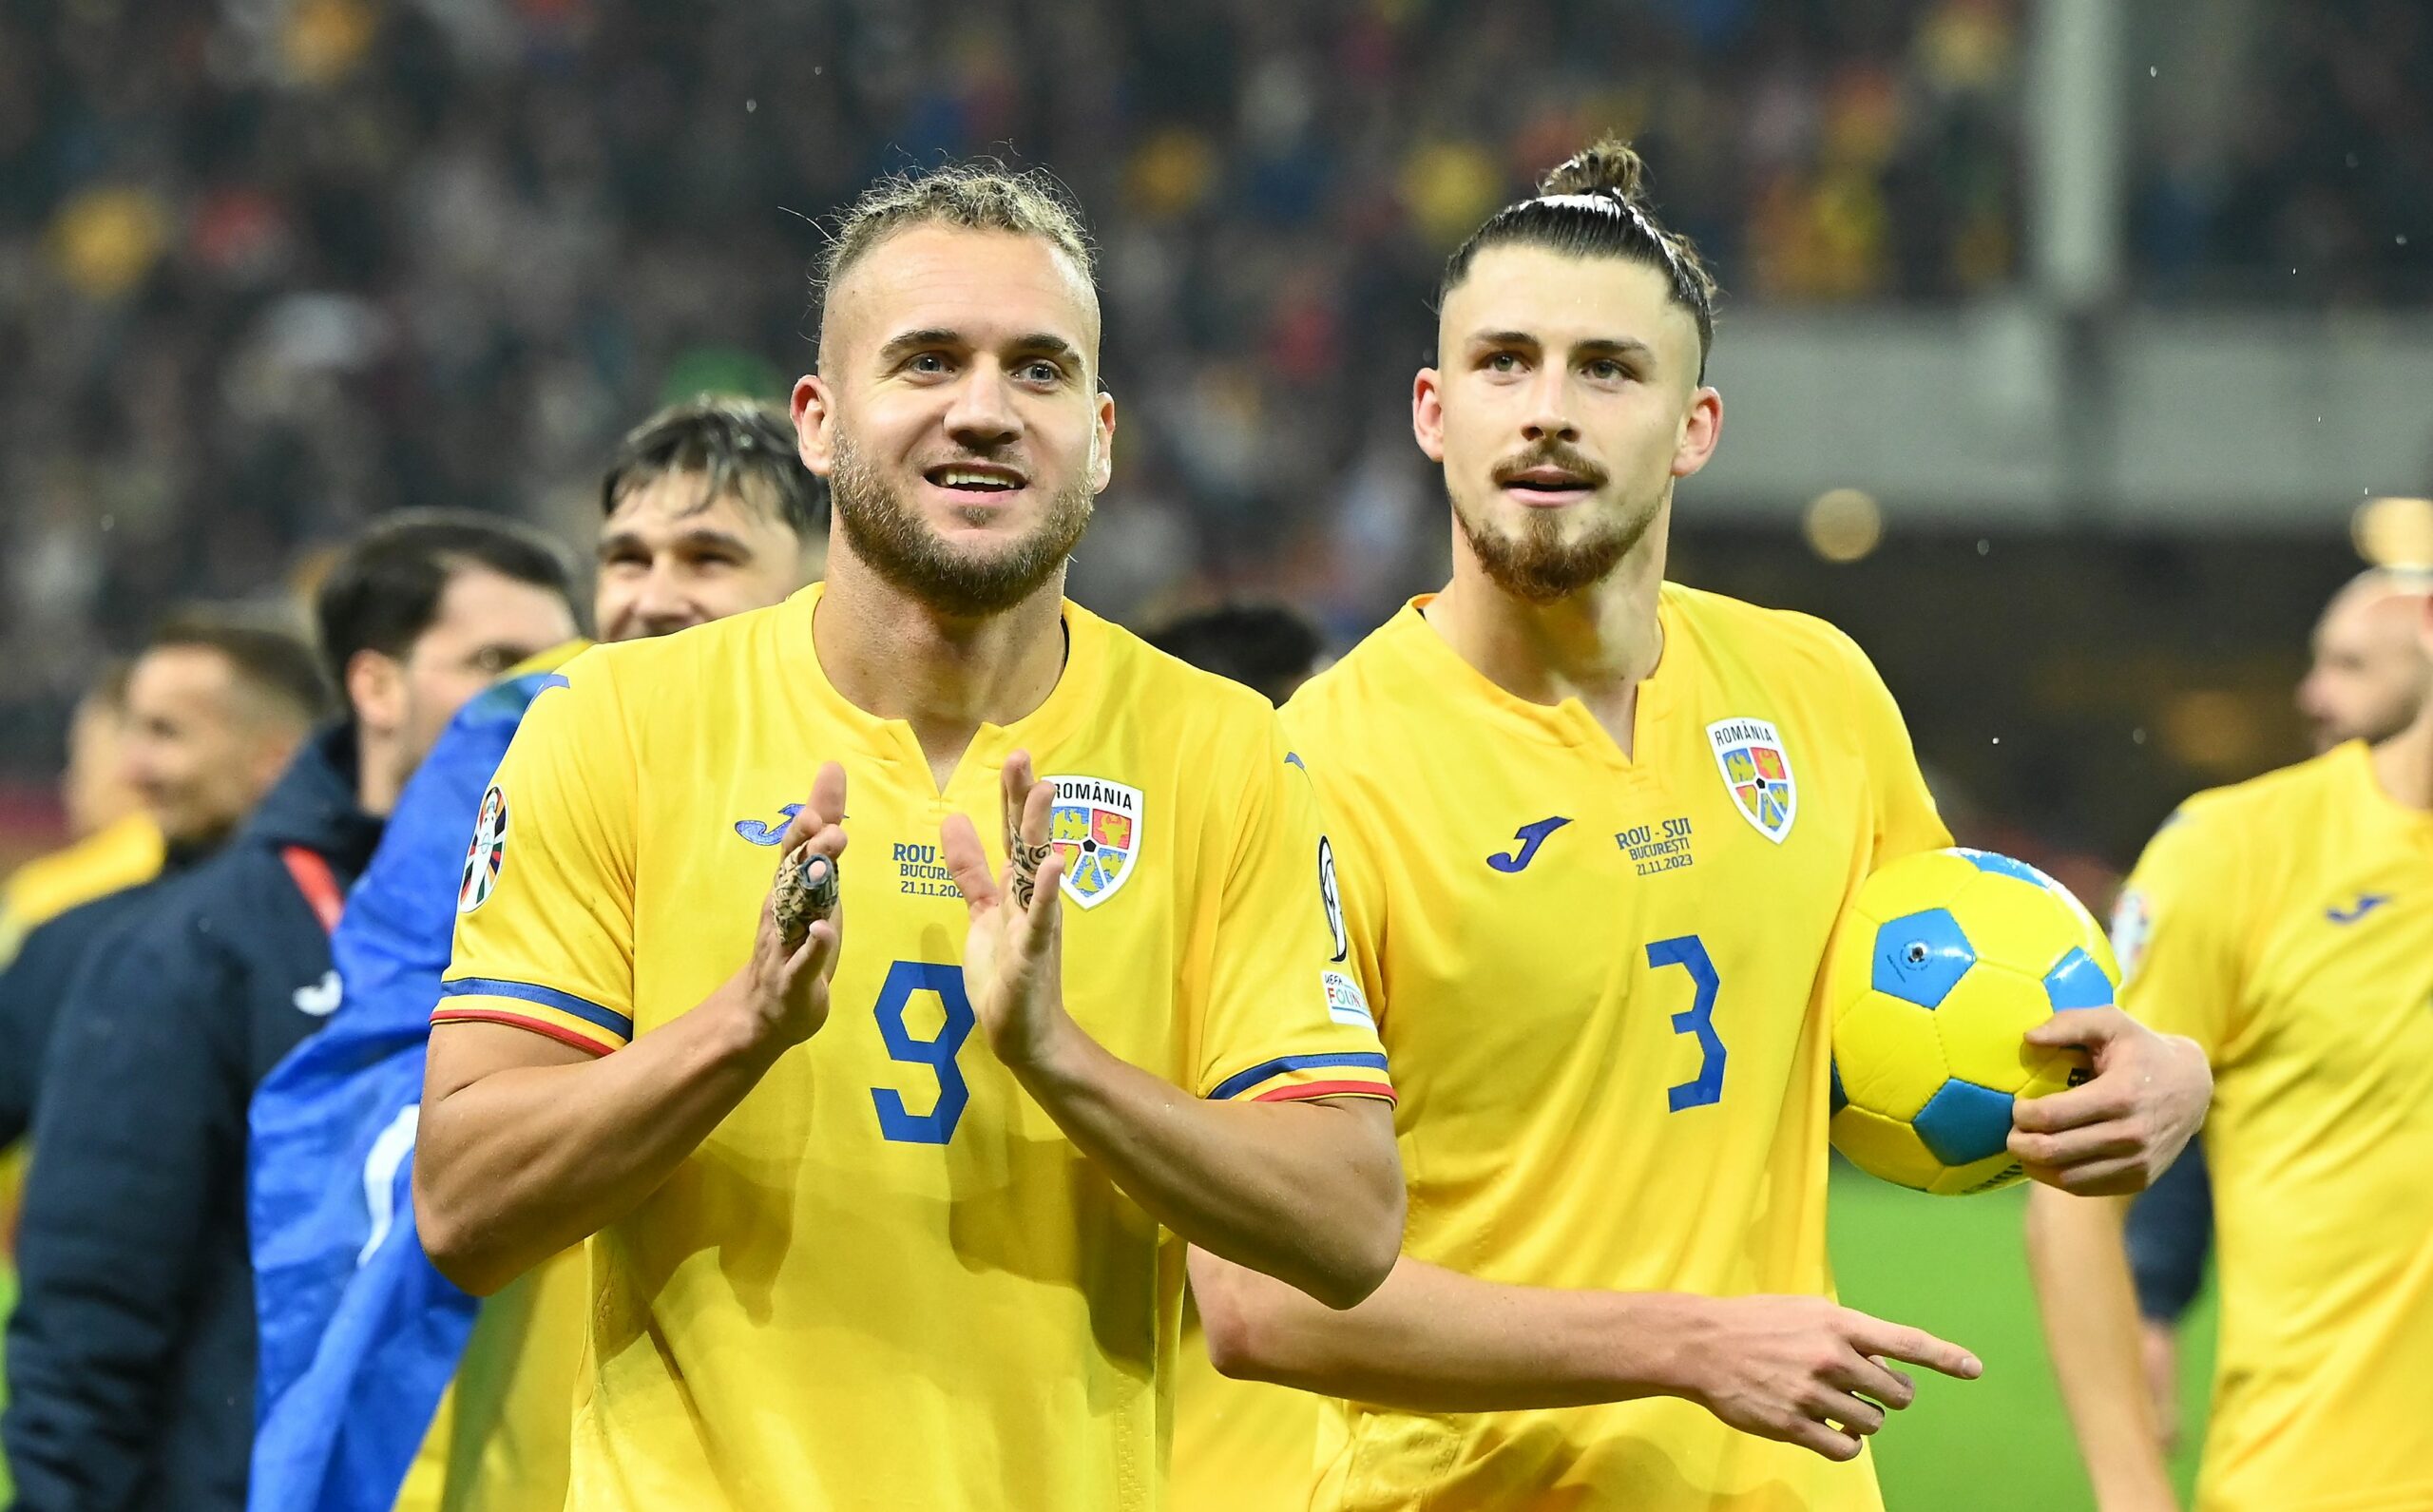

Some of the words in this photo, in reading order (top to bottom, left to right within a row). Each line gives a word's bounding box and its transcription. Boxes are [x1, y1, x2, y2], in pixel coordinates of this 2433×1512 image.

[1615, 825, 1652, 850] ROU
[1662, 817, 1692, 838] SUI
[892, 843, 935, 864] ROU
[1637, 853, 1693, 876] 21.11.2023
[1645, 934, 1727, 1113] 3
[870, 960, 976, 1145] 9
